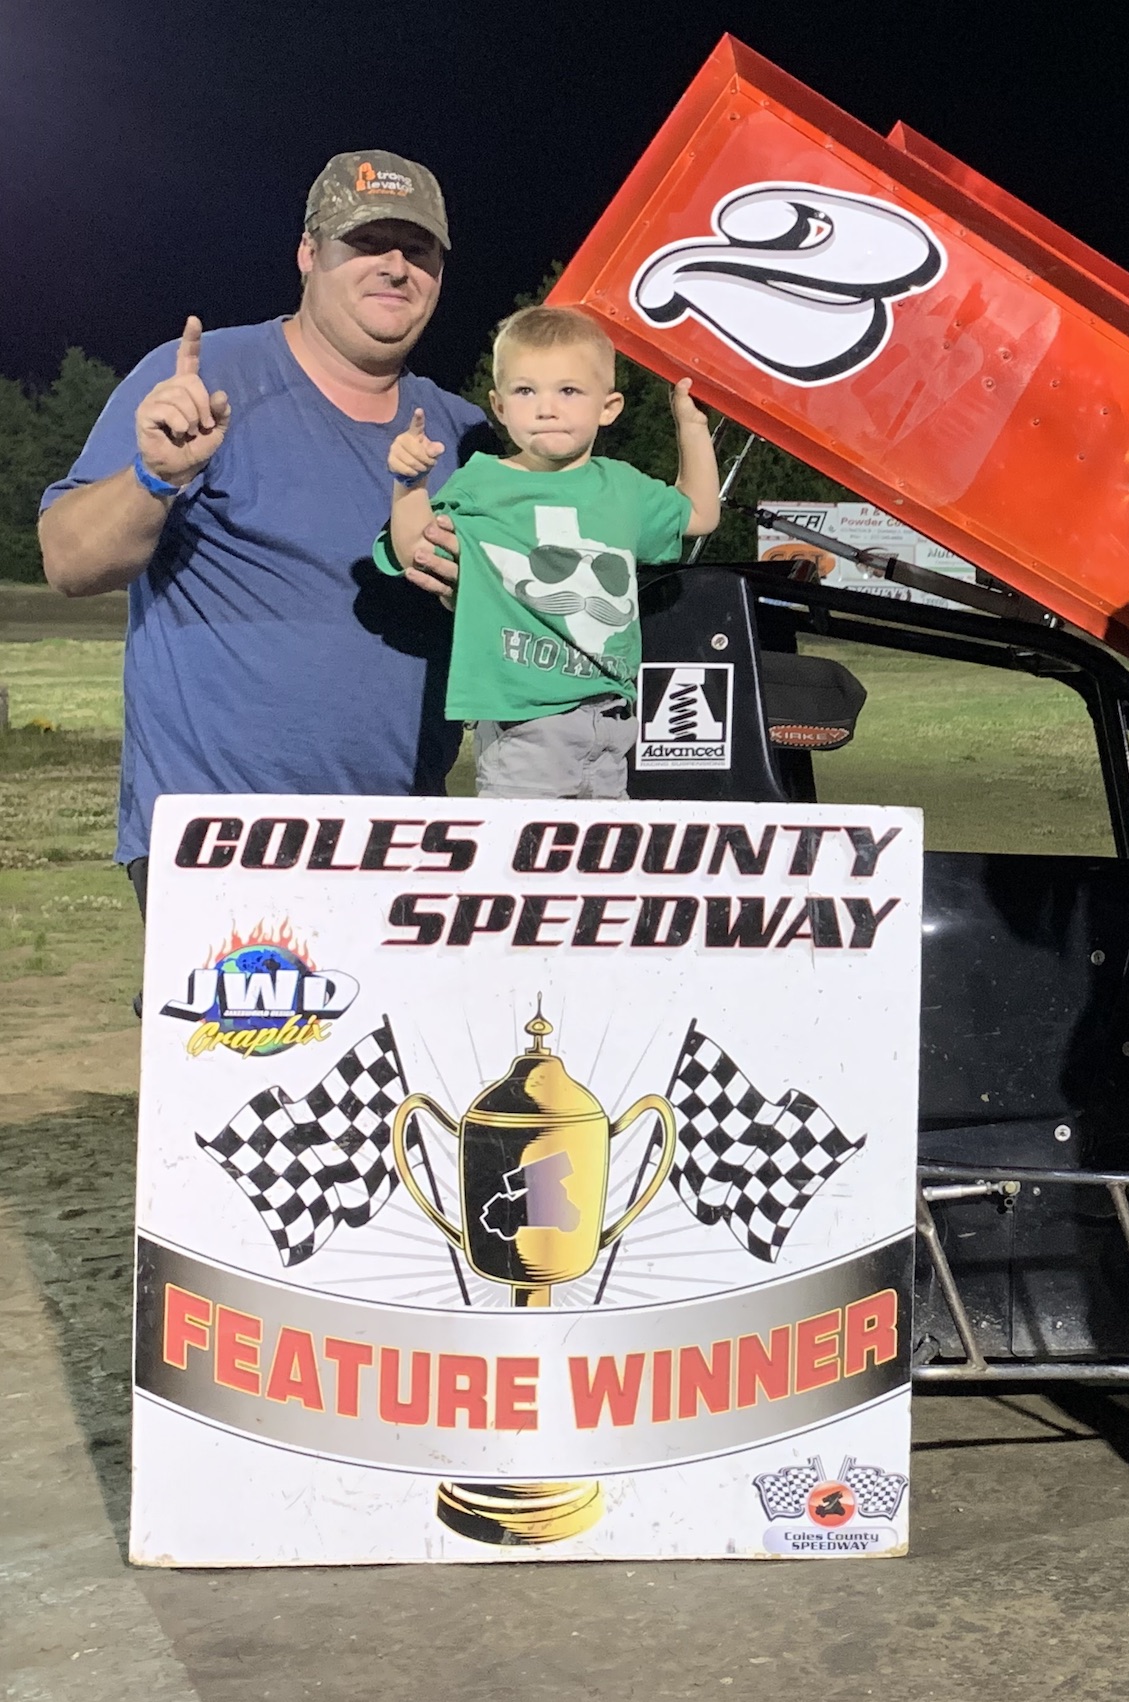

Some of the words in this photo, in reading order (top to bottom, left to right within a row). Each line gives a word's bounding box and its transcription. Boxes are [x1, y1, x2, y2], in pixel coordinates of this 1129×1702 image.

[629, 181, 948, 388] 2
[640, 744, 726, 758] Advanced
[771, 731, 840, 741] KIRKEY
[173, 816, 485, 873] COLES
[511, 821, 904, 878] COUNTY
[380, 893, 903, 951] SPEEDWAY
[159, 968, 360, 1022] JWD
[187, 1014, 333, 1060] Graphix
[161, 1282, 540, 1432] FEATURE
[568, 1288, 899, 1431] WINNER
[784, 1531, 824, 1541] Coles
[826, 1531, 879, 1543] County
[791, 1541, 869, 1551] SPEEDWAY
